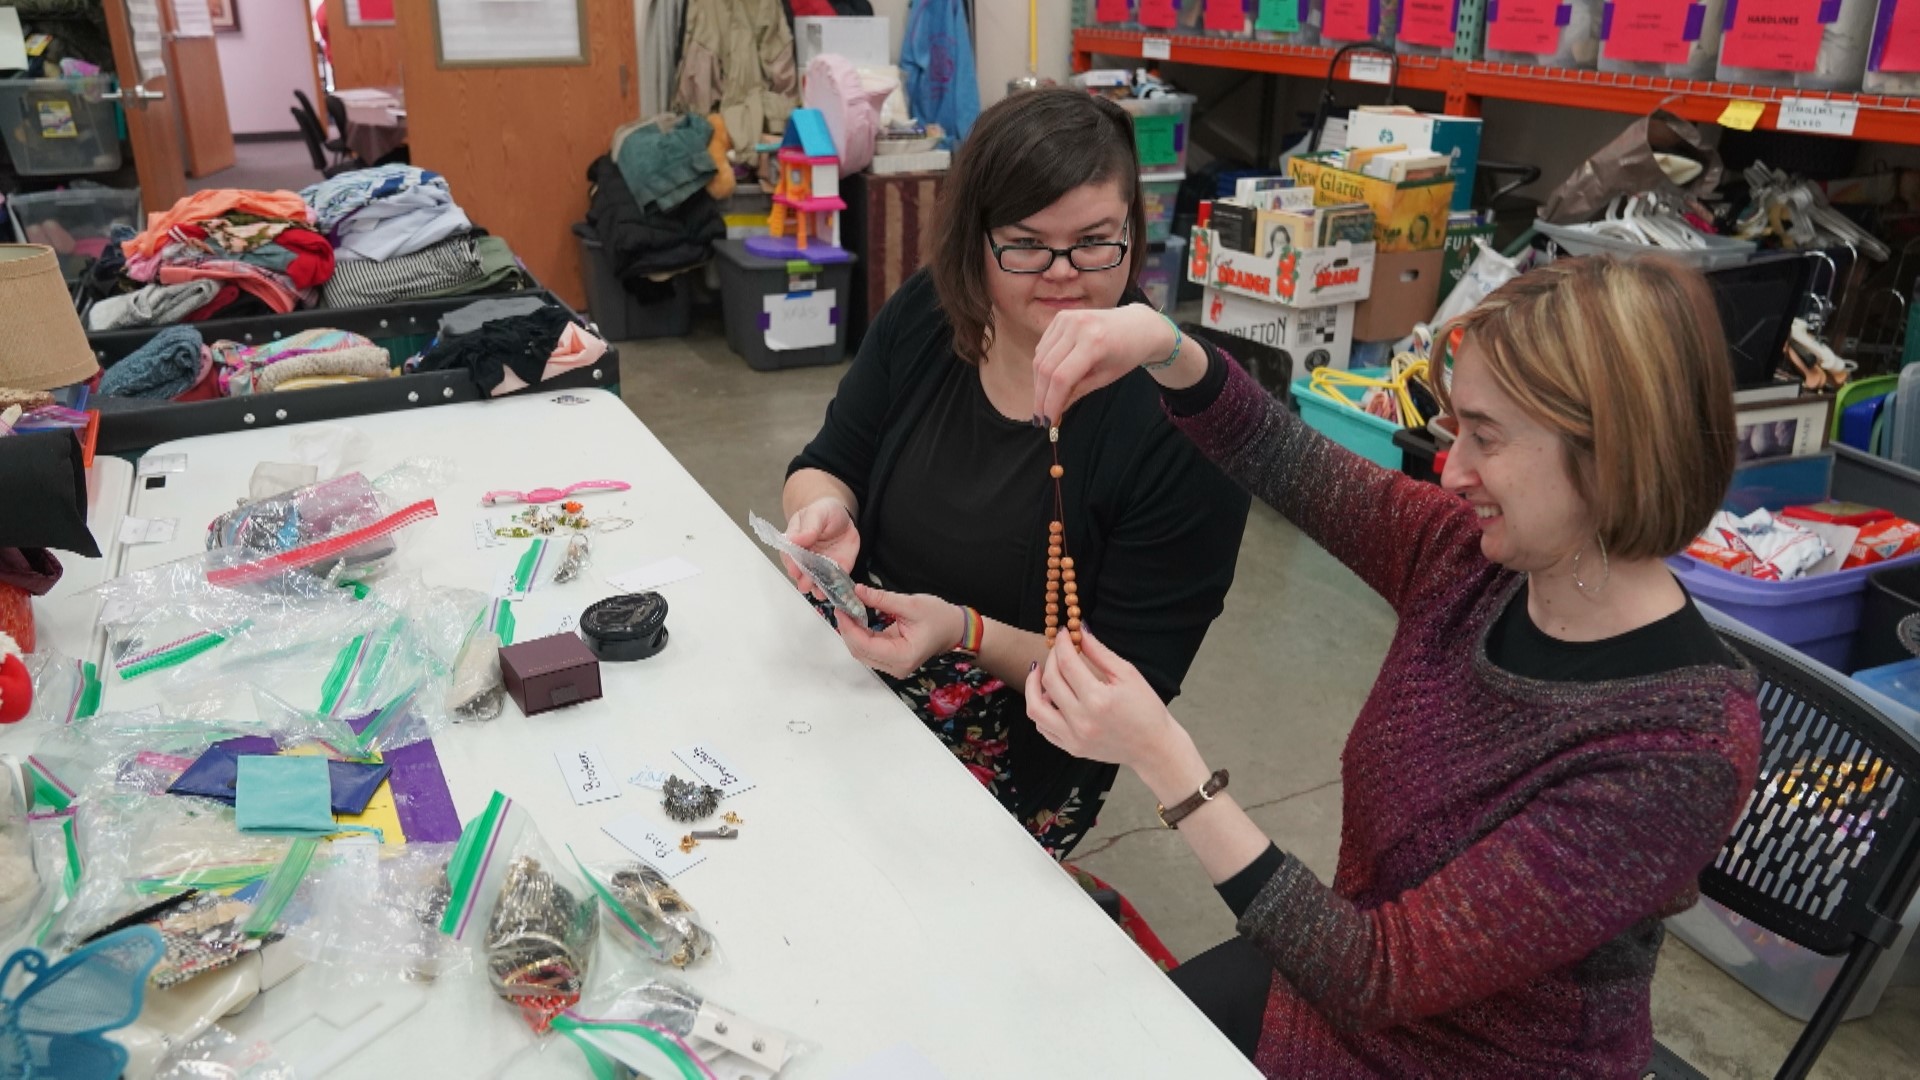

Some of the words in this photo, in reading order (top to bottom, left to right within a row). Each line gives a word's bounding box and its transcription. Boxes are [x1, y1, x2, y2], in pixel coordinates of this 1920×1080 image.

[1747, 14, 1800, 26] HARDLINES
[1292, 162, 1318, 186] New
[1319, 170, 1365, 201] Glarus
[1217, 263, 1272, 297] ORANGE
